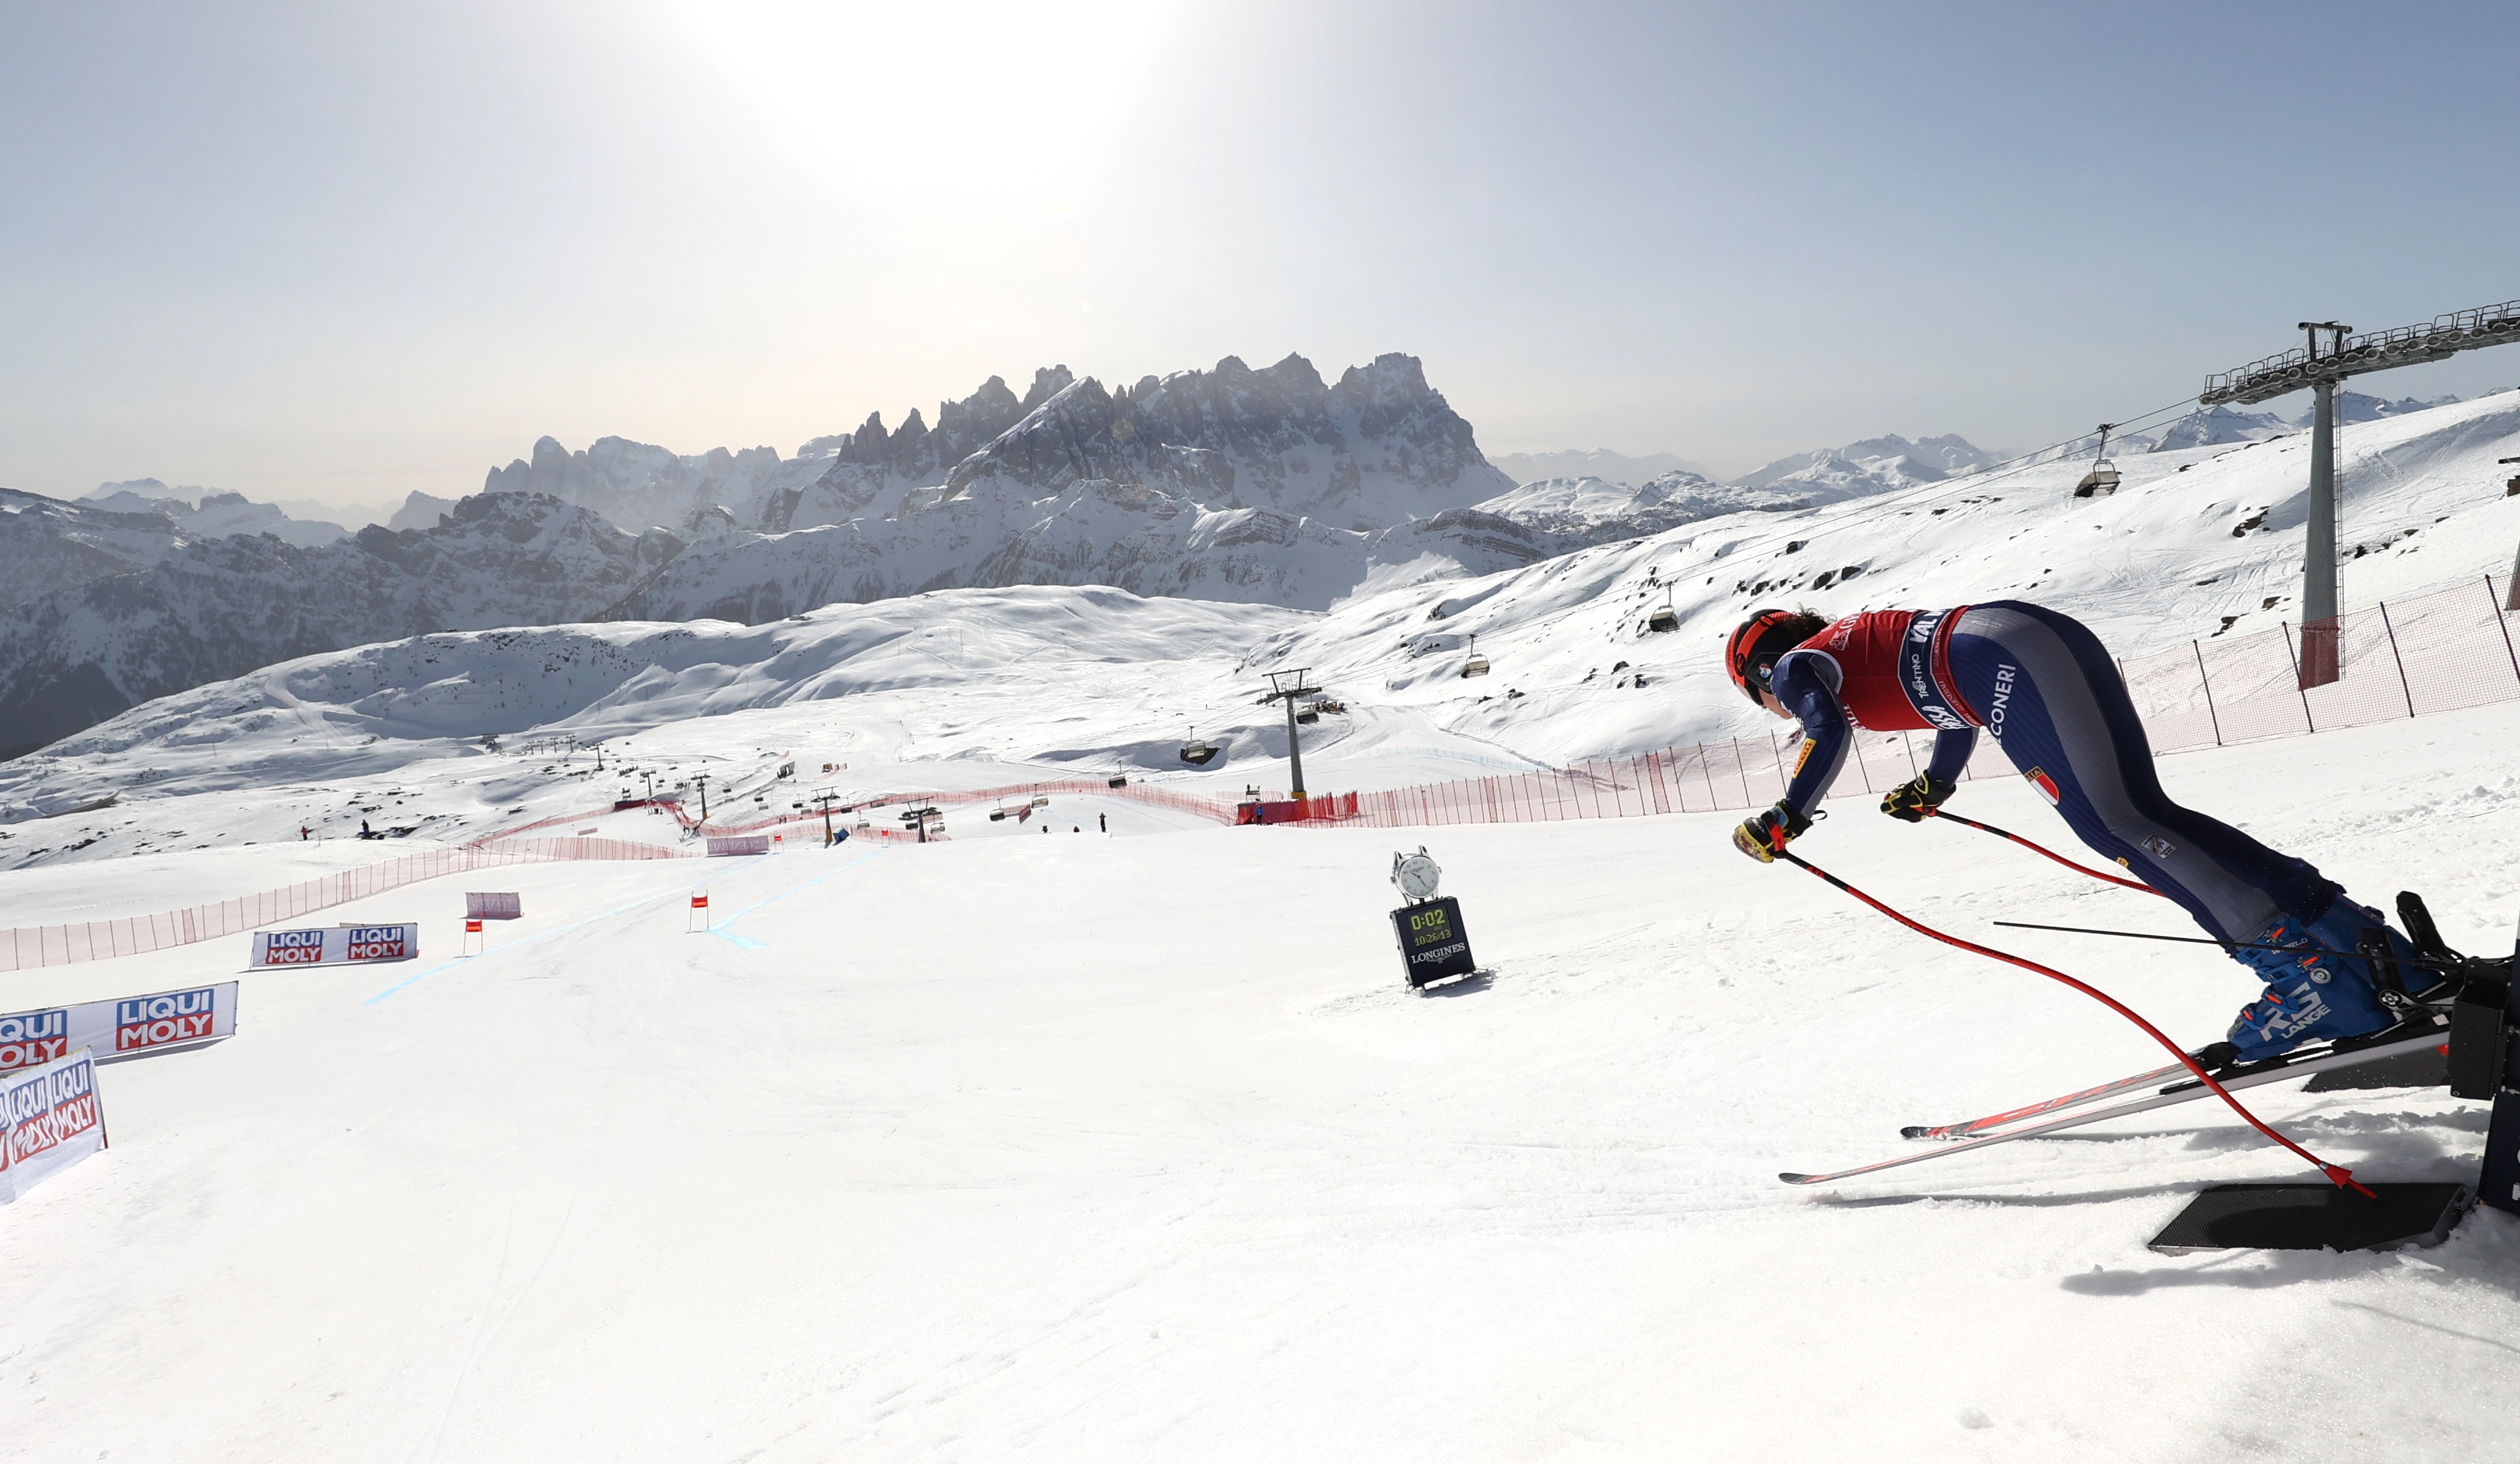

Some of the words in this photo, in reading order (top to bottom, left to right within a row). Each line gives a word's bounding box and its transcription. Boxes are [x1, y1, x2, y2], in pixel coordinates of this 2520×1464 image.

[1909, 618, 1938, 643] VAL
[1911, 653, 1929, 699] TRENTINO
[1410, 909, 1446, 931] 0:02
[270, 931, 321, 948] LIQUI
[350, 942, 403, 958] MOLY
[351, 928, 402, 943] LIQUI
[268, 947, 321, 964] MOLY
[1410, 942, 1466, 964] LONGINES
[122, 991, 210, 1024] LIQUI
[2280, 1004, 2332, 1039] LANGE
[120, 1013, 211, 1049] MOLY
[52, 1063, 90, 1105] LIQUI
[10, 1079, 47, 1123] LIQUI
[55, 1094, 93, 1139] MOLY
